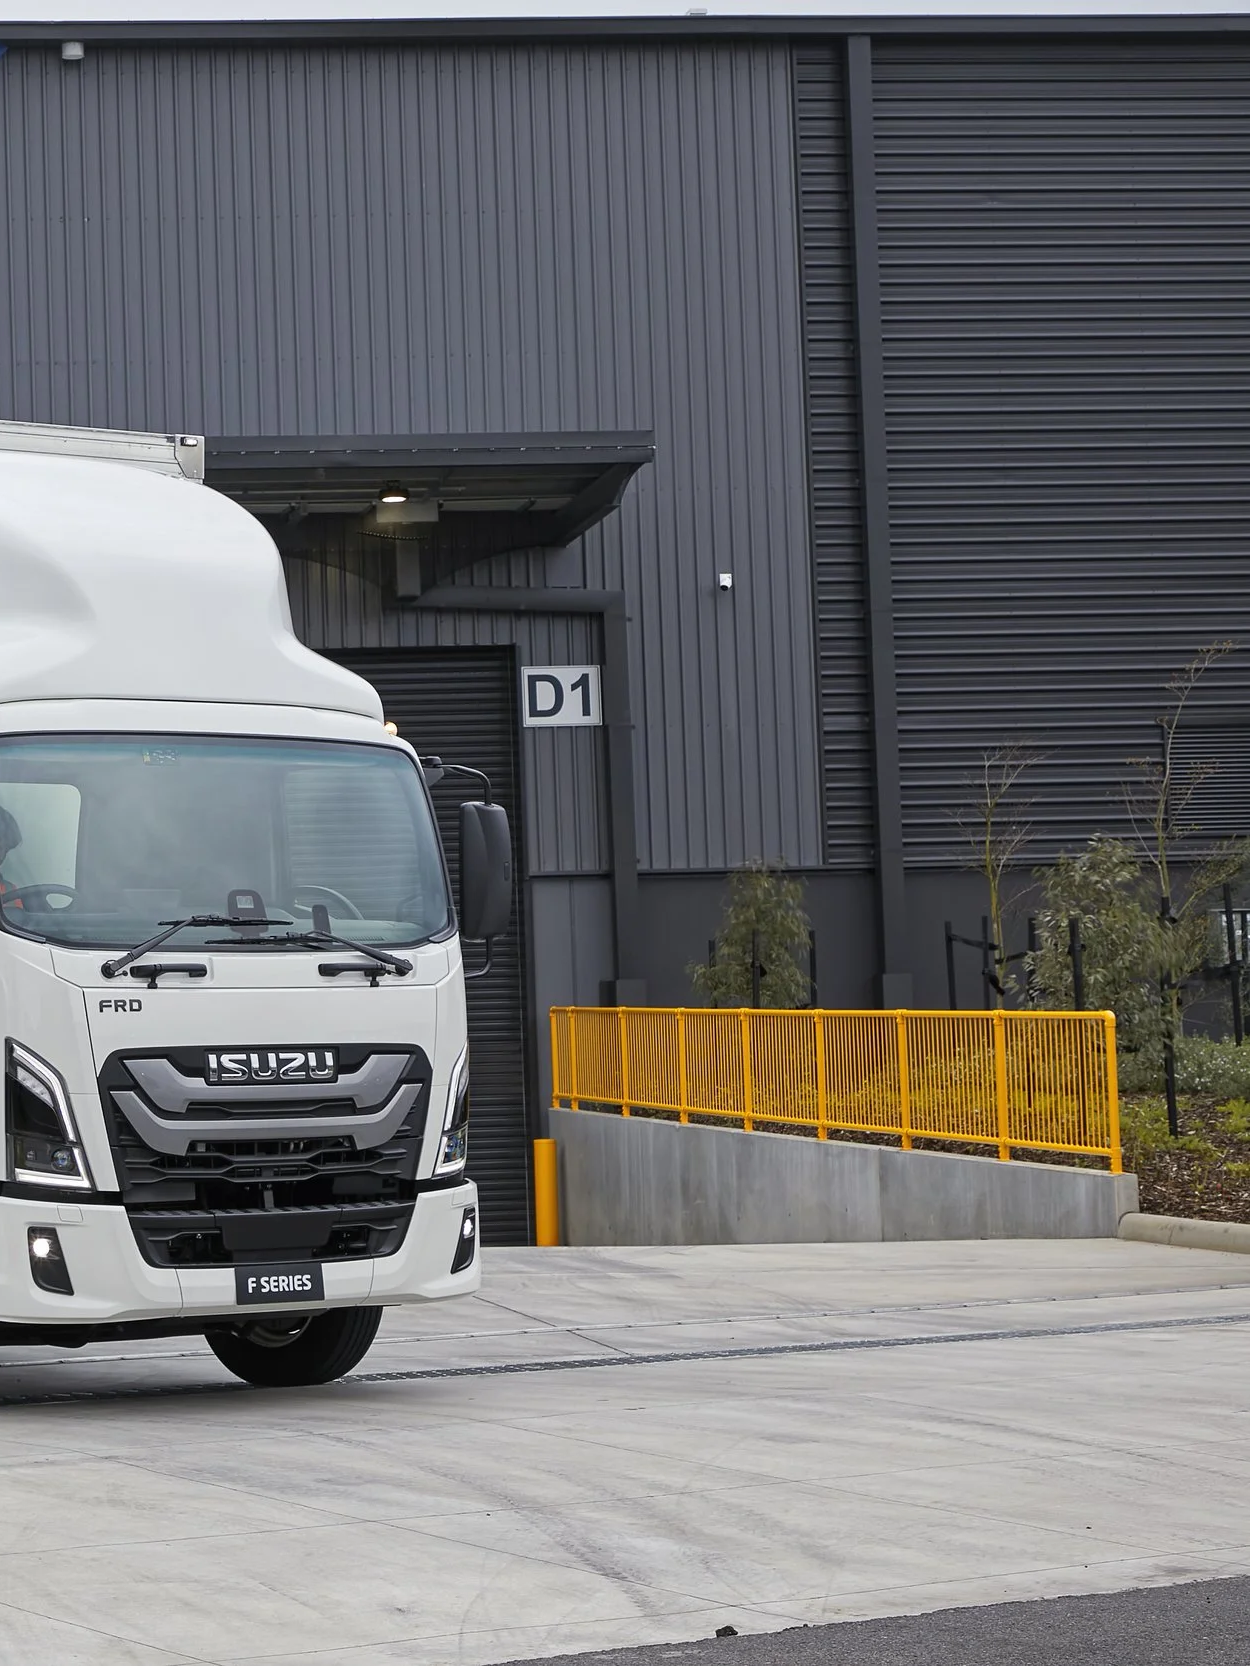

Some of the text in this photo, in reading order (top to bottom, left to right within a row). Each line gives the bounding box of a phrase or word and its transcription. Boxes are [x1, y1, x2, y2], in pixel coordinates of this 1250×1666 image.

[527, 673, 591, 718] D1
[98, 999, 143, 1013] FRD
[208, 1051, 334, 1082] ISUZU
[247, 1274, 312, 1293] F SERIES
